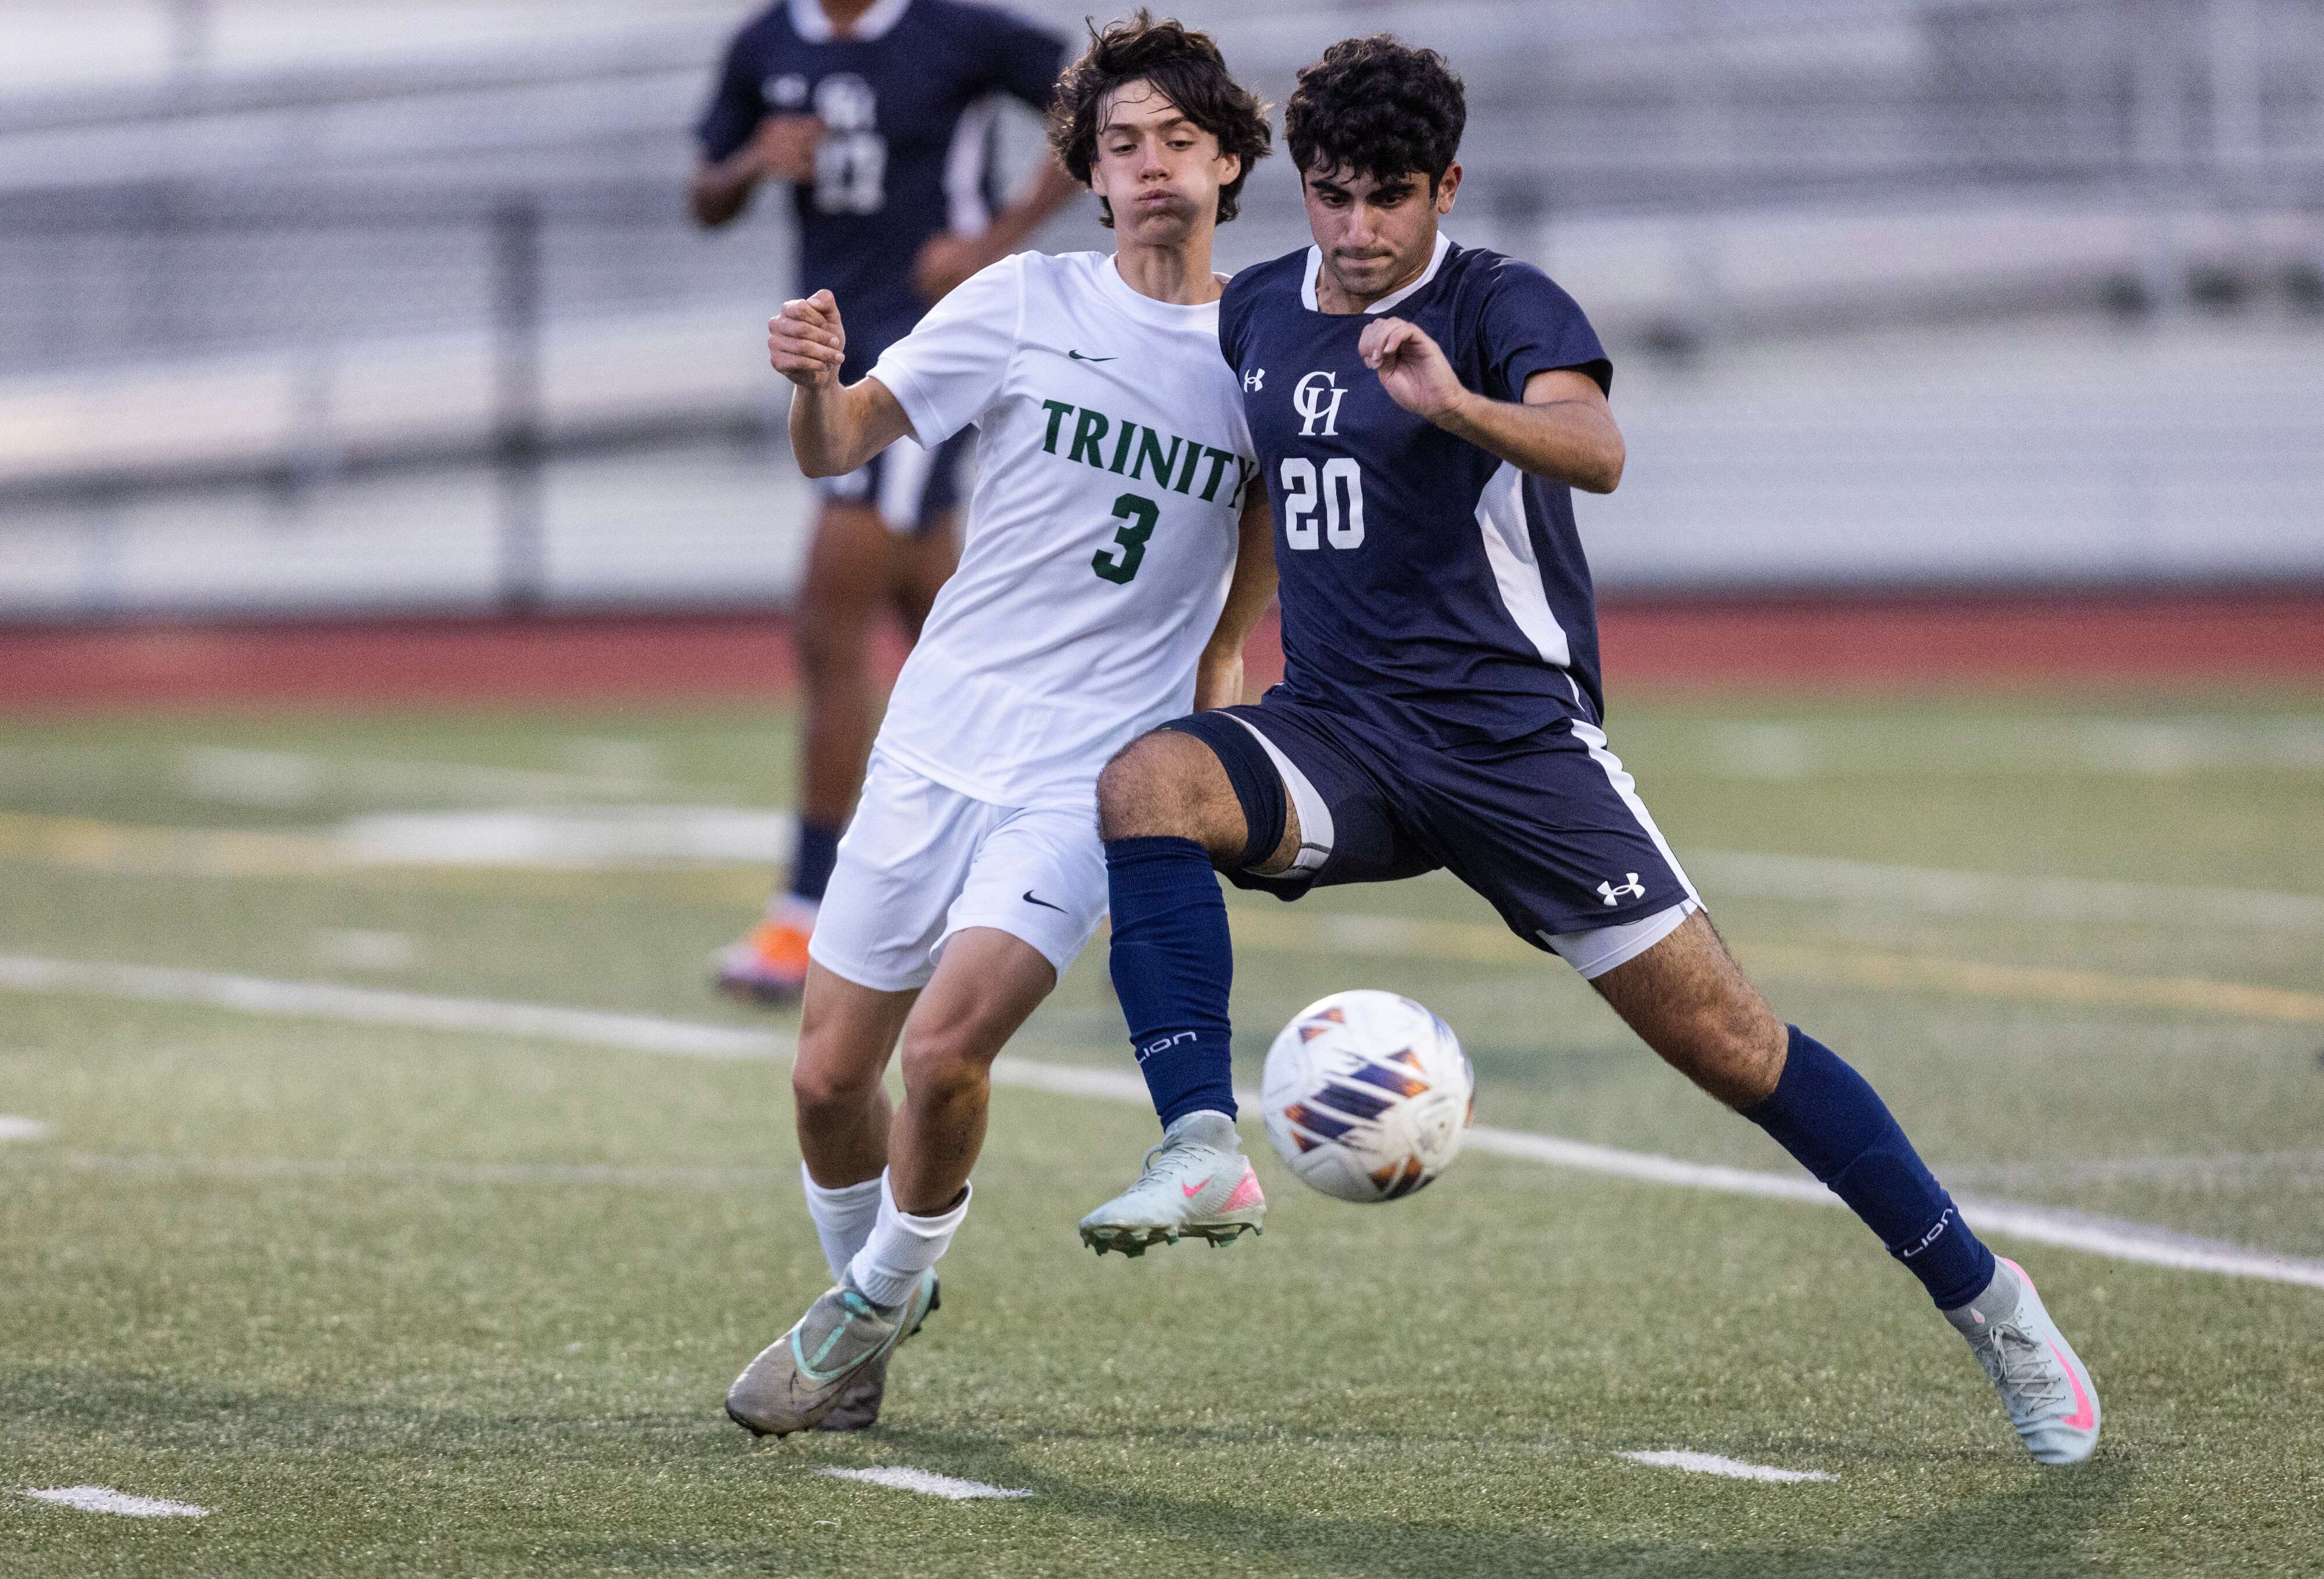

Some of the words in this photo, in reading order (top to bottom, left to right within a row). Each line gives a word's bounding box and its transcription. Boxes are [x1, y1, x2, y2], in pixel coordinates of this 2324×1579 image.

[1041, 399, 1256, 509] TRINITY
[1091, 492, 1160, 585] 3
[1280, 457, 1366, 550] 20
